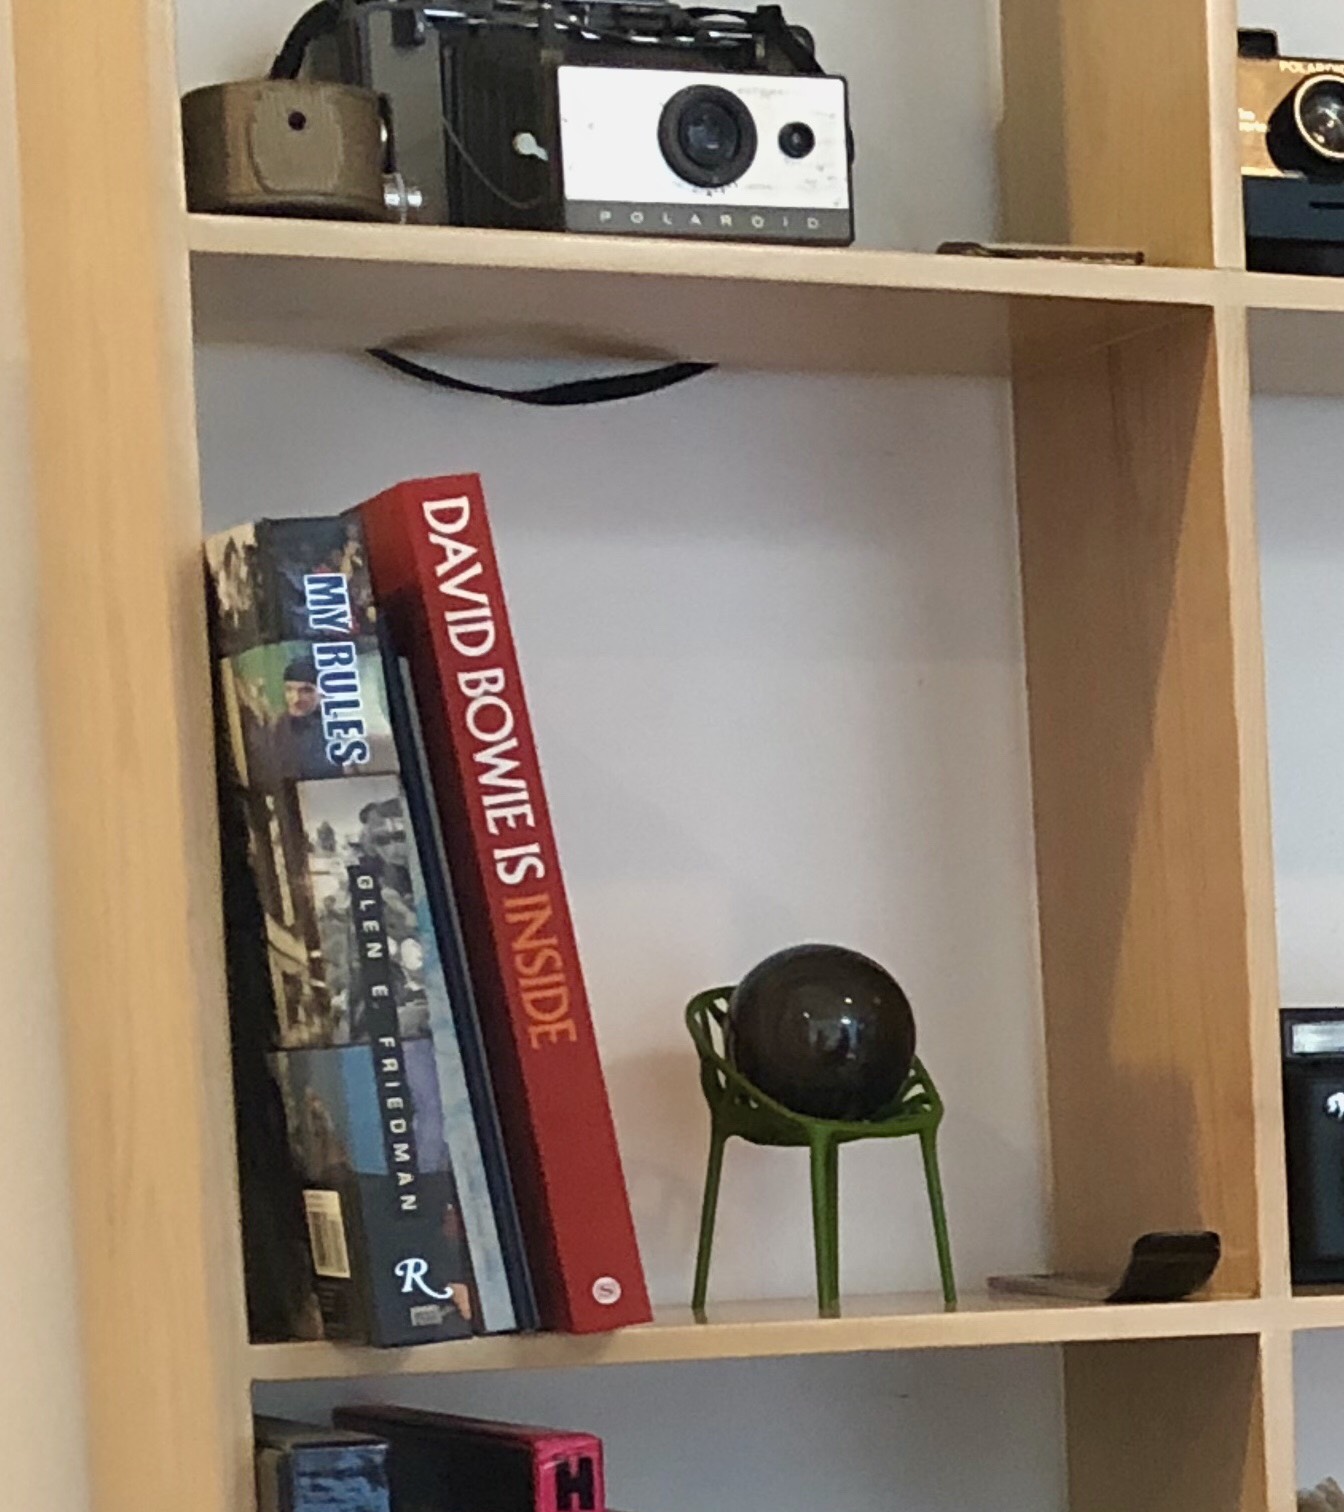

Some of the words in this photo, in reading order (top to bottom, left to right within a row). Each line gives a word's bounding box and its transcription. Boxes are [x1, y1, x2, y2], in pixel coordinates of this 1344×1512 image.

[599, 210, 819, 230] POLAROID
[302, 572, 354, 635] MY
[422, 495, 496, 658] DAVID
[312, 640, 370, 767] RULES
[455, 668, 536, 836] BOWIE
[492, 843, 546, 886] IS
[504, 892, 578, 1050] INSIDE
[355, 874, 383, 959] GLEN
[378, 1036, 419, 1212] FRIEDMAN
